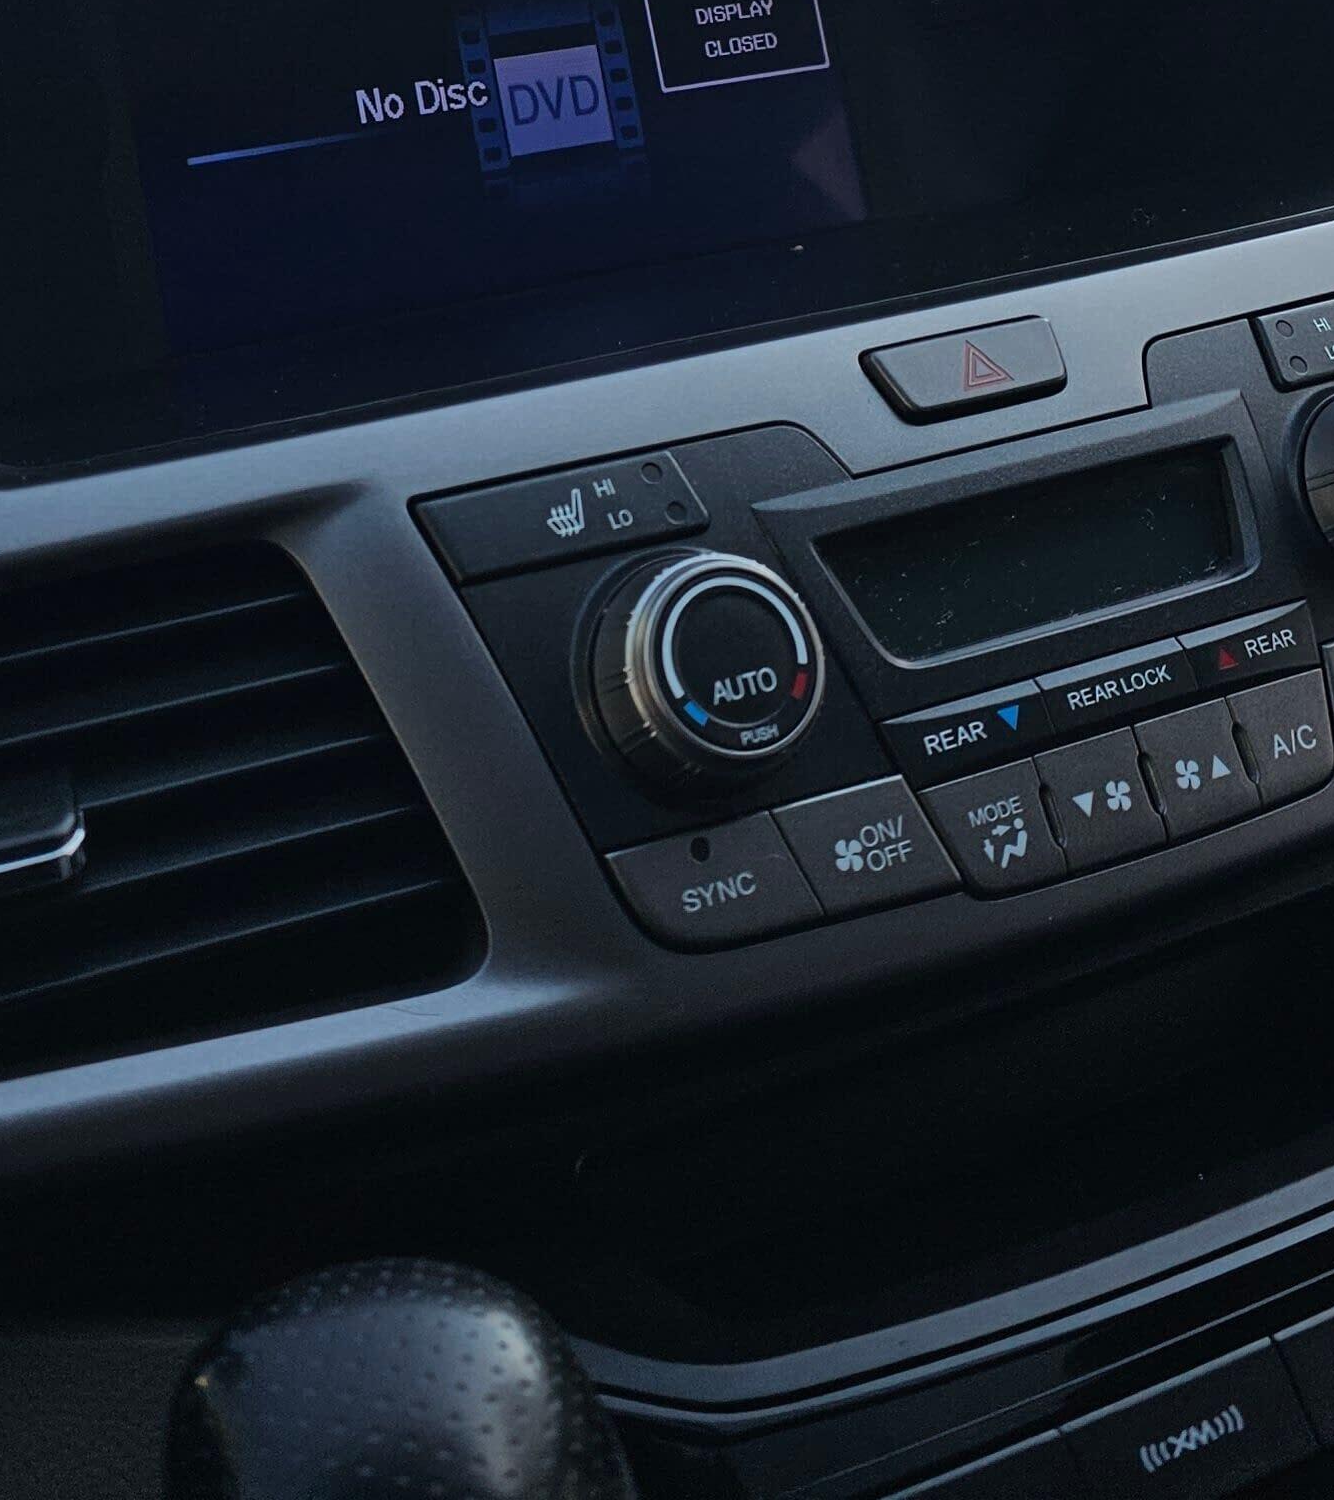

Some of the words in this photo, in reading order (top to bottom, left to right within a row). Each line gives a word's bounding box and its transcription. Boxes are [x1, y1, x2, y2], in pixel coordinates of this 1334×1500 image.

[704, 32, 778, 59] CLOSED
[355, 87, 405, 124] No
[414, 78, 489, 116] Disc
[508, 75, 600, 126] DVD
[1313, 318, 1332, 333] HI
[592, 478, 616, 498] HI
[607, 509, 634, 531] LO
[1243, 629, 1297, 659] REAR
[713, 666, 778, 706] AUTO
[1067, 679, 1121, 710] REAR
[1122, 664, 1171, 694] LOCK
[740, 723, 780, 746] PUSH
[923, 720, 988, 756] REAR
[1272, 725, 1317, 759] A/C
[968, 795, 1025, 828] MODE
[860, 815, 903, 848] ON/
[867, 840, 913, 872] OFF
[681, 871, 756, 914] SYNC
